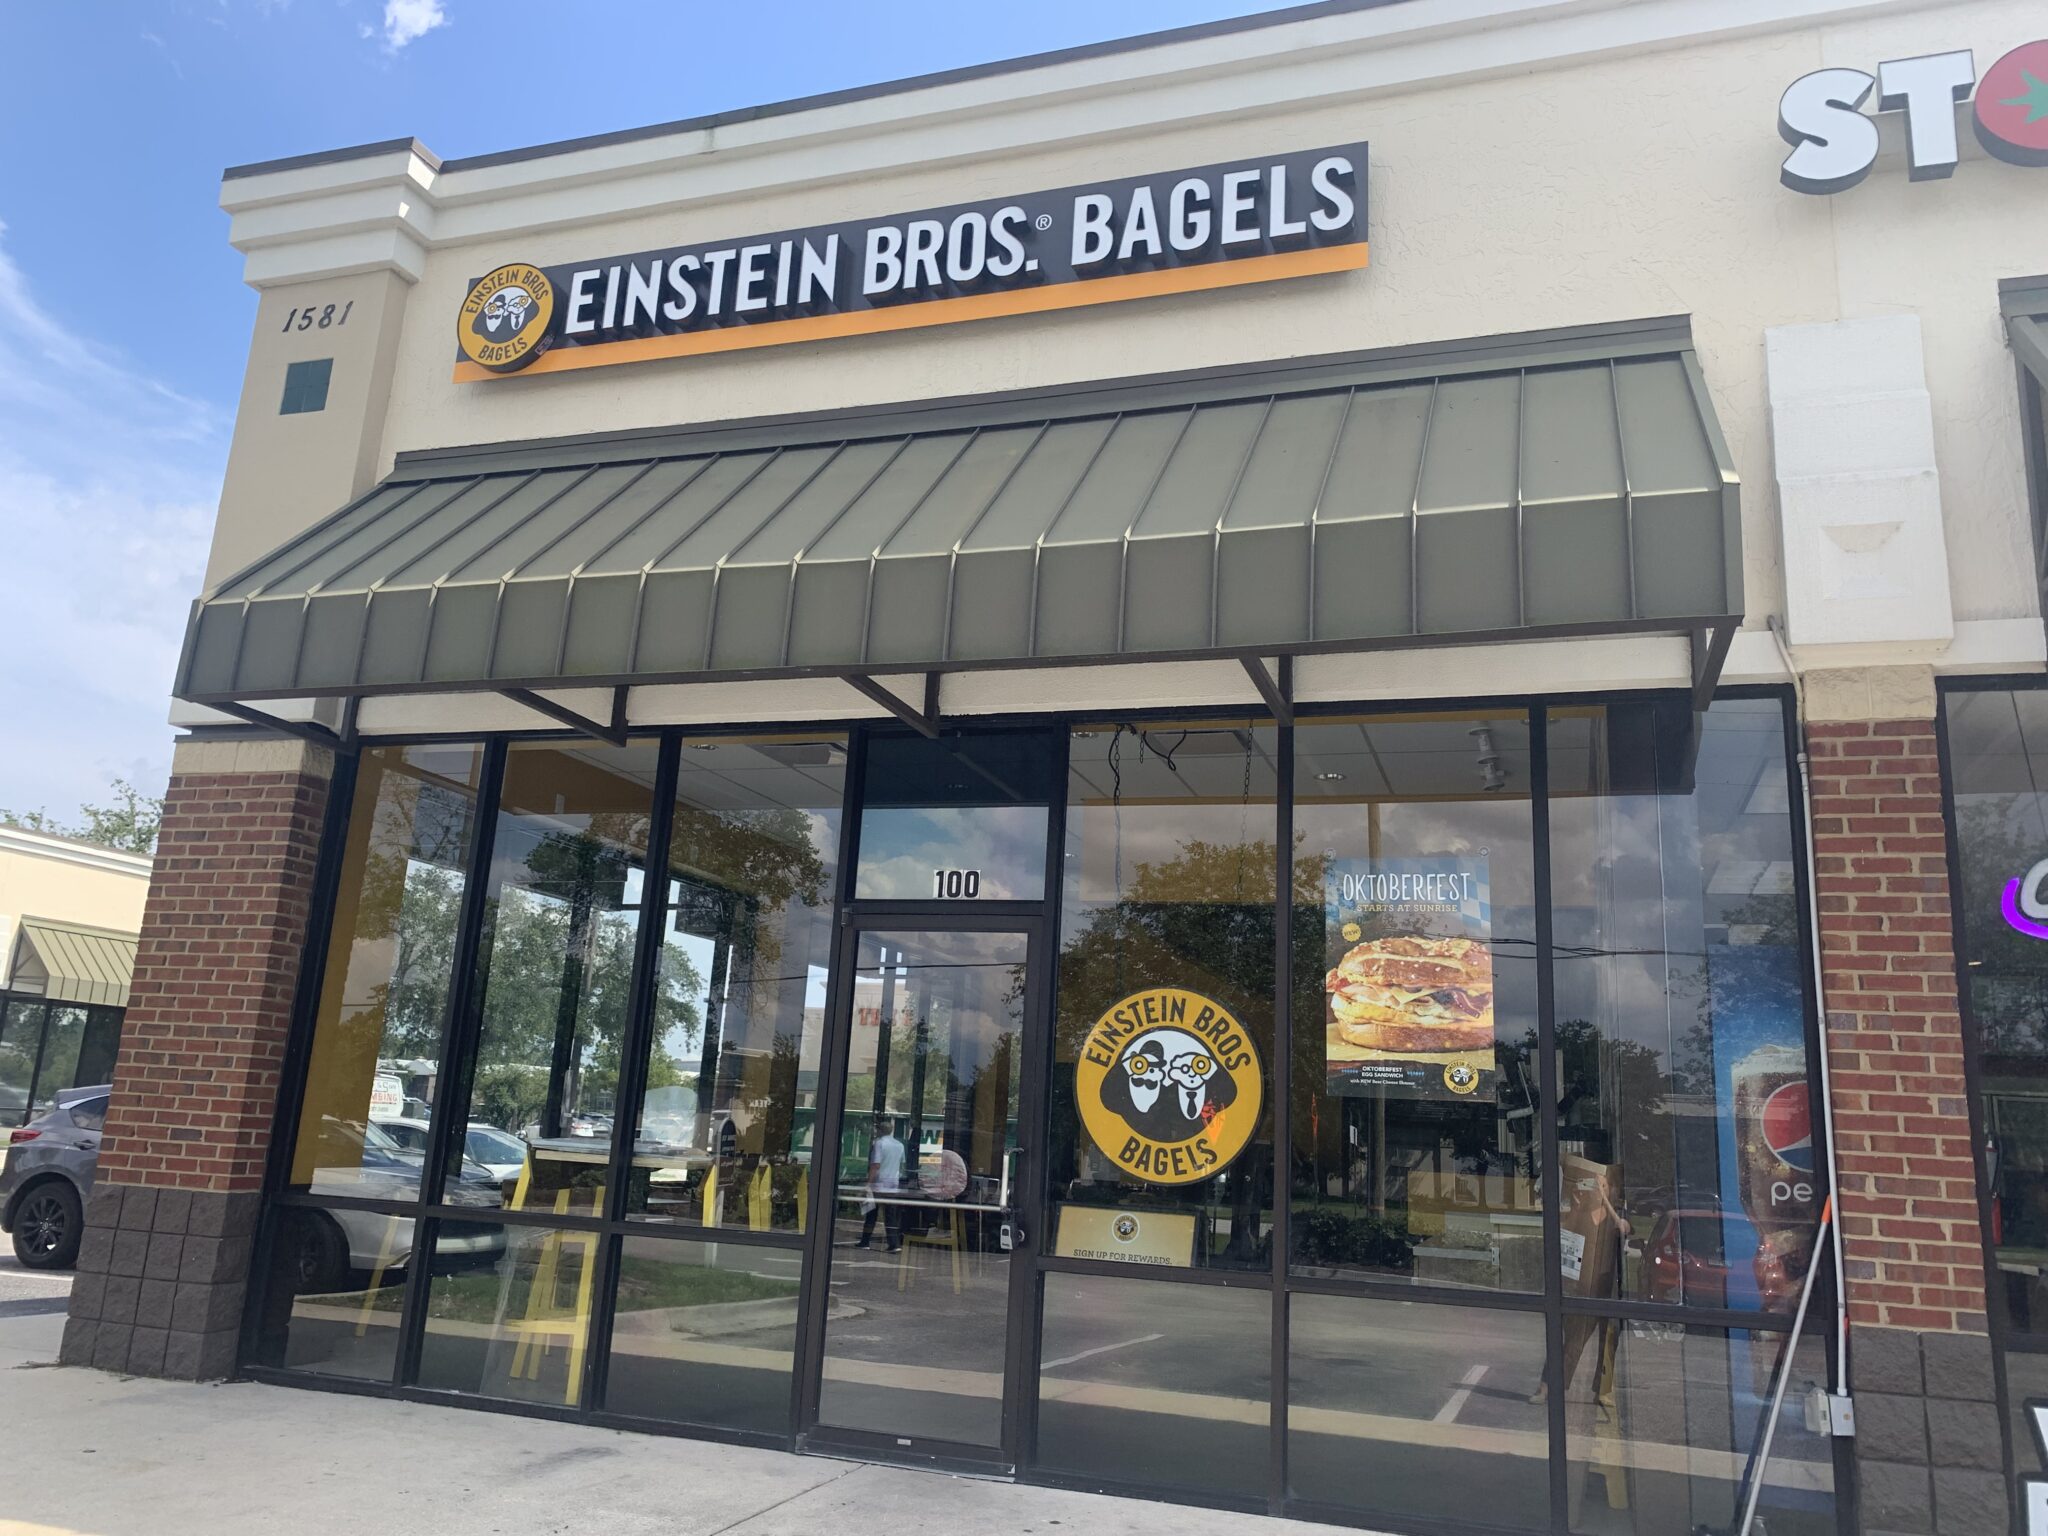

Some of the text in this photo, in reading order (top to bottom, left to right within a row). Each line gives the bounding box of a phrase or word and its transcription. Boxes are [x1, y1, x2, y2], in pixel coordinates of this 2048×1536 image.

[564, 234, 839, 335] EINSTEIN
[1070, 156, 1354, 267] BAGELS
[465, 268, 549, 314] EINSTEIN BROS
[282, 300, 354, 333] 1581
[478, 337, 528, 361] BAGELS
[935, 870, 980, 898] 100
[1342, 872, 1471, 901] OKTOBERFEST
[1356, 904, 1458, 912] STARTS AT SUNRISE
[1085, 995, 1251, 1071] EINSTEIN BROS
[1118, 1136, 1218, 1176] BAGELS
[1073, 1249, 1173, 1265] SIGN UP FOR REWARDS.
